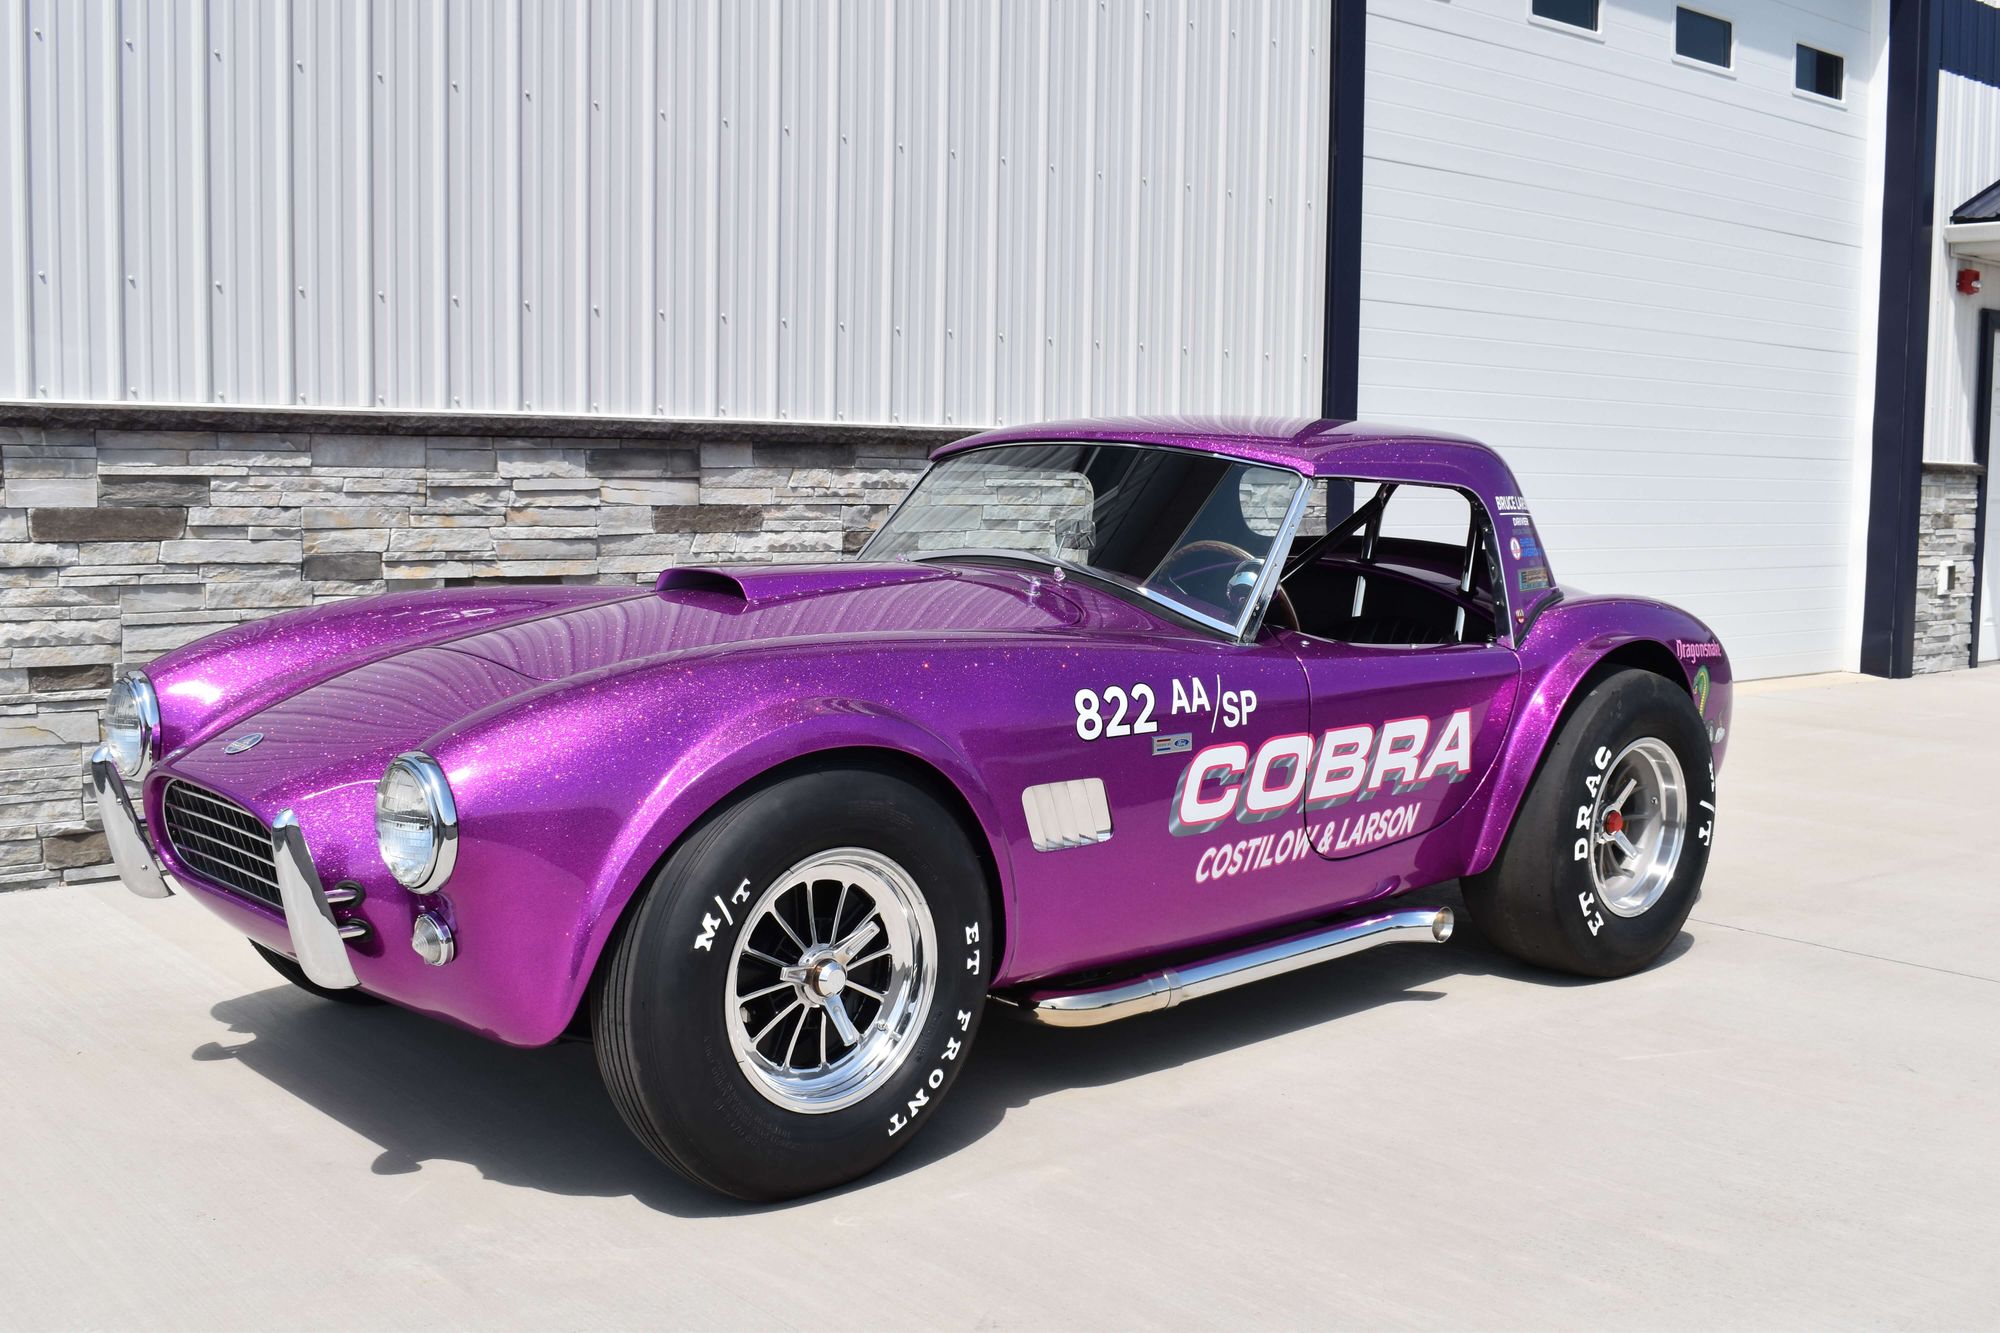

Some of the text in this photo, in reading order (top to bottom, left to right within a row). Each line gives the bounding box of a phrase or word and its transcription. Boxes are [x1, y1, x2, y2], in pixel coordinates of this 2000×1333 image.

[1073, 682, 1159, 742] 822
[1174, 707, 1472, 833] COBRA
[1195, 801, 1422, 883] COSTILOW & LARSON
[694, 878, 751, 952] M/T
[965, 921, 980, 975] ET
[1578, 891, 1605, 937] ET
[887, 1009, 972, 1137] FRONT
